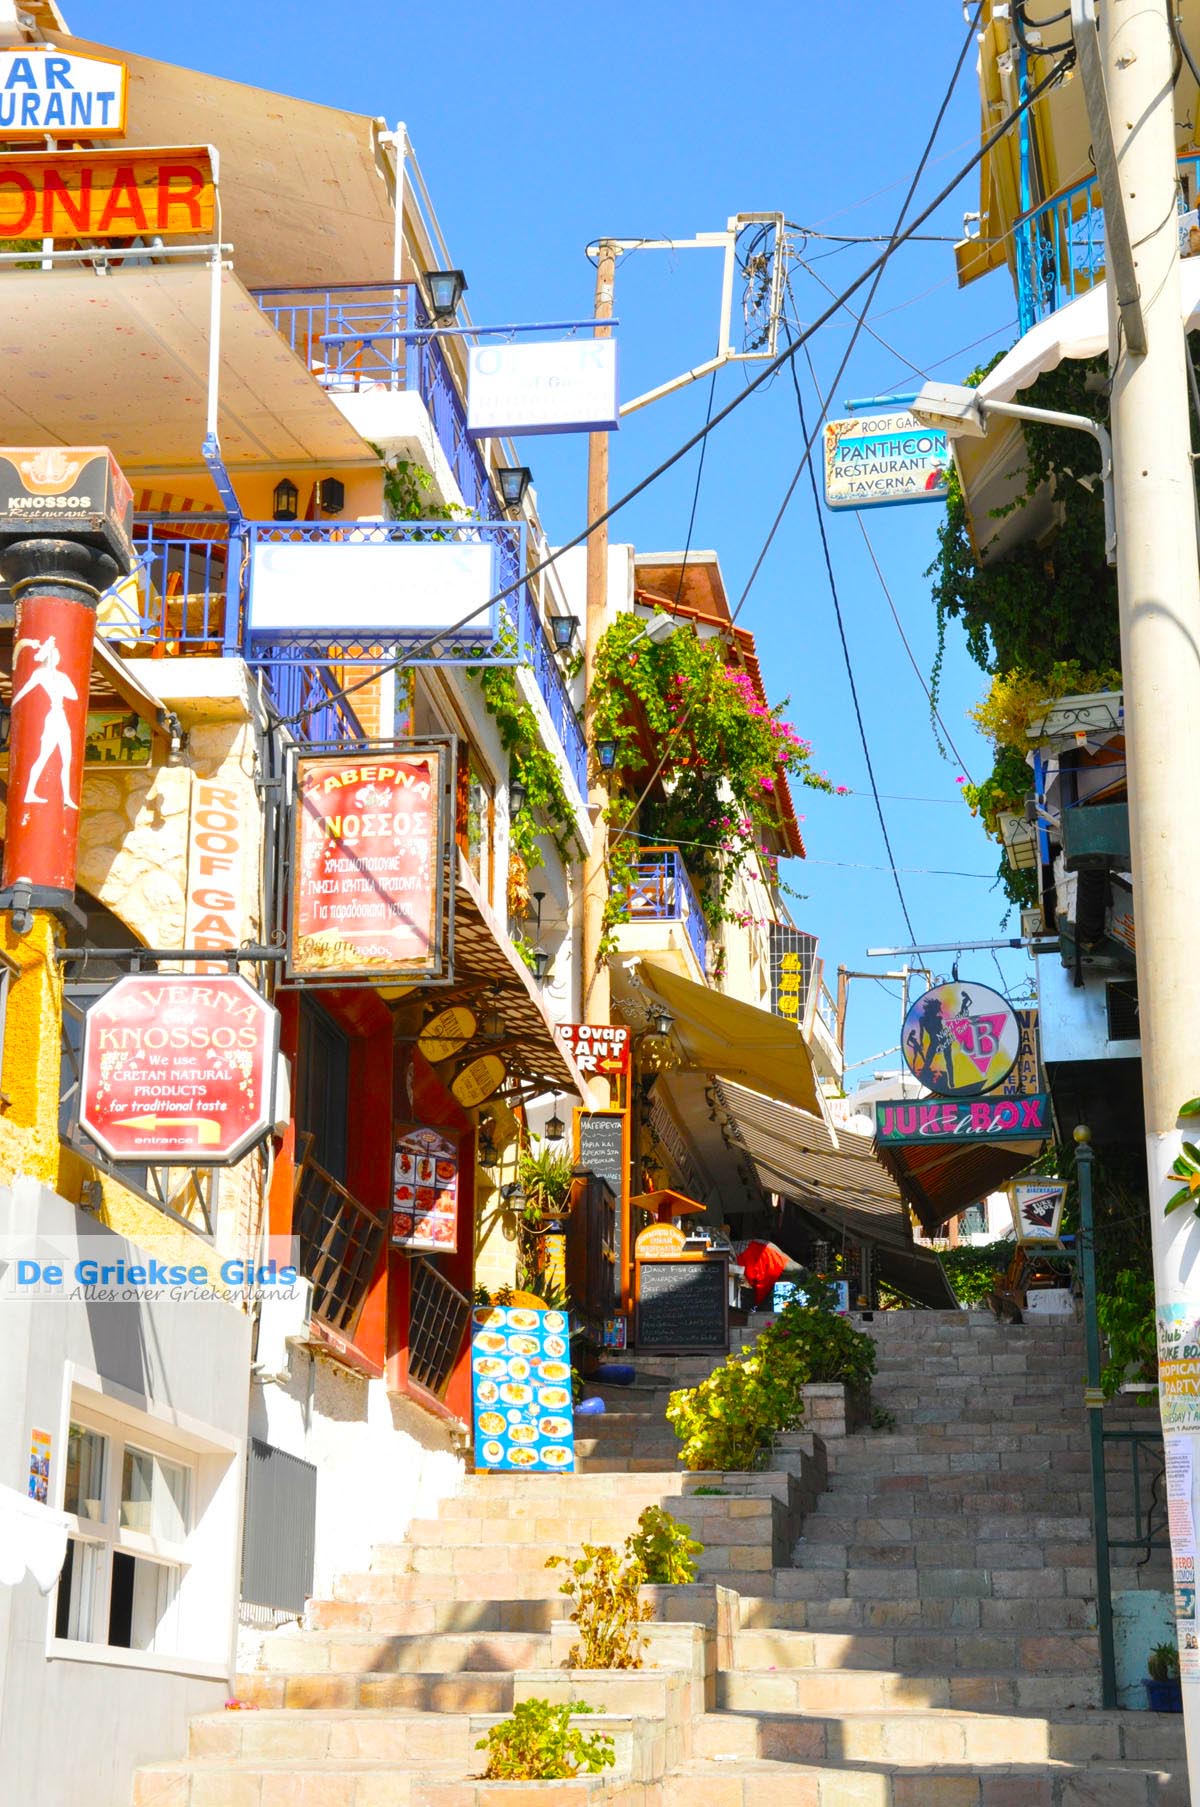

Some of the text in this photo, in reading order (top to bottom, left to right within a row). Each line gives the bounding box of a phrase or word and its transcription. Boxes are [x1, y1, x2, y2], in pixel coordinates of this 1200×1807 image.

[0, 165, 205, 236] ONAR
[861, 416, 920, 433] ROOF GAR
[841, 435, 947, 462] PANTHEON
[835, 457, 928, 478] RESTAURANT
[848, 476, 916, 493] TAVERNA
[8, 496, 92, 509] KNOSSOS
[9, 508, 87, 518] Restaurant
[195, 786, 240, 876] ROOF
[96, 986, 258, 1025] TAVERNA
[98, 1027, 258, 1049] KNOSSOS
[150, 1055, 197, 1066] We use
[113, 1069, 232, 1081] CRETAN NATURAL
[134, 1085, 207, 1096] PRODUCTS
[109, 1099, 227, 1112] for traditional taste
[882, 1100, 1042, 1135] JUKE BOX
[919, 1114, 1002, 1136] Club
[134, 1136, 193, 1144] entrance
